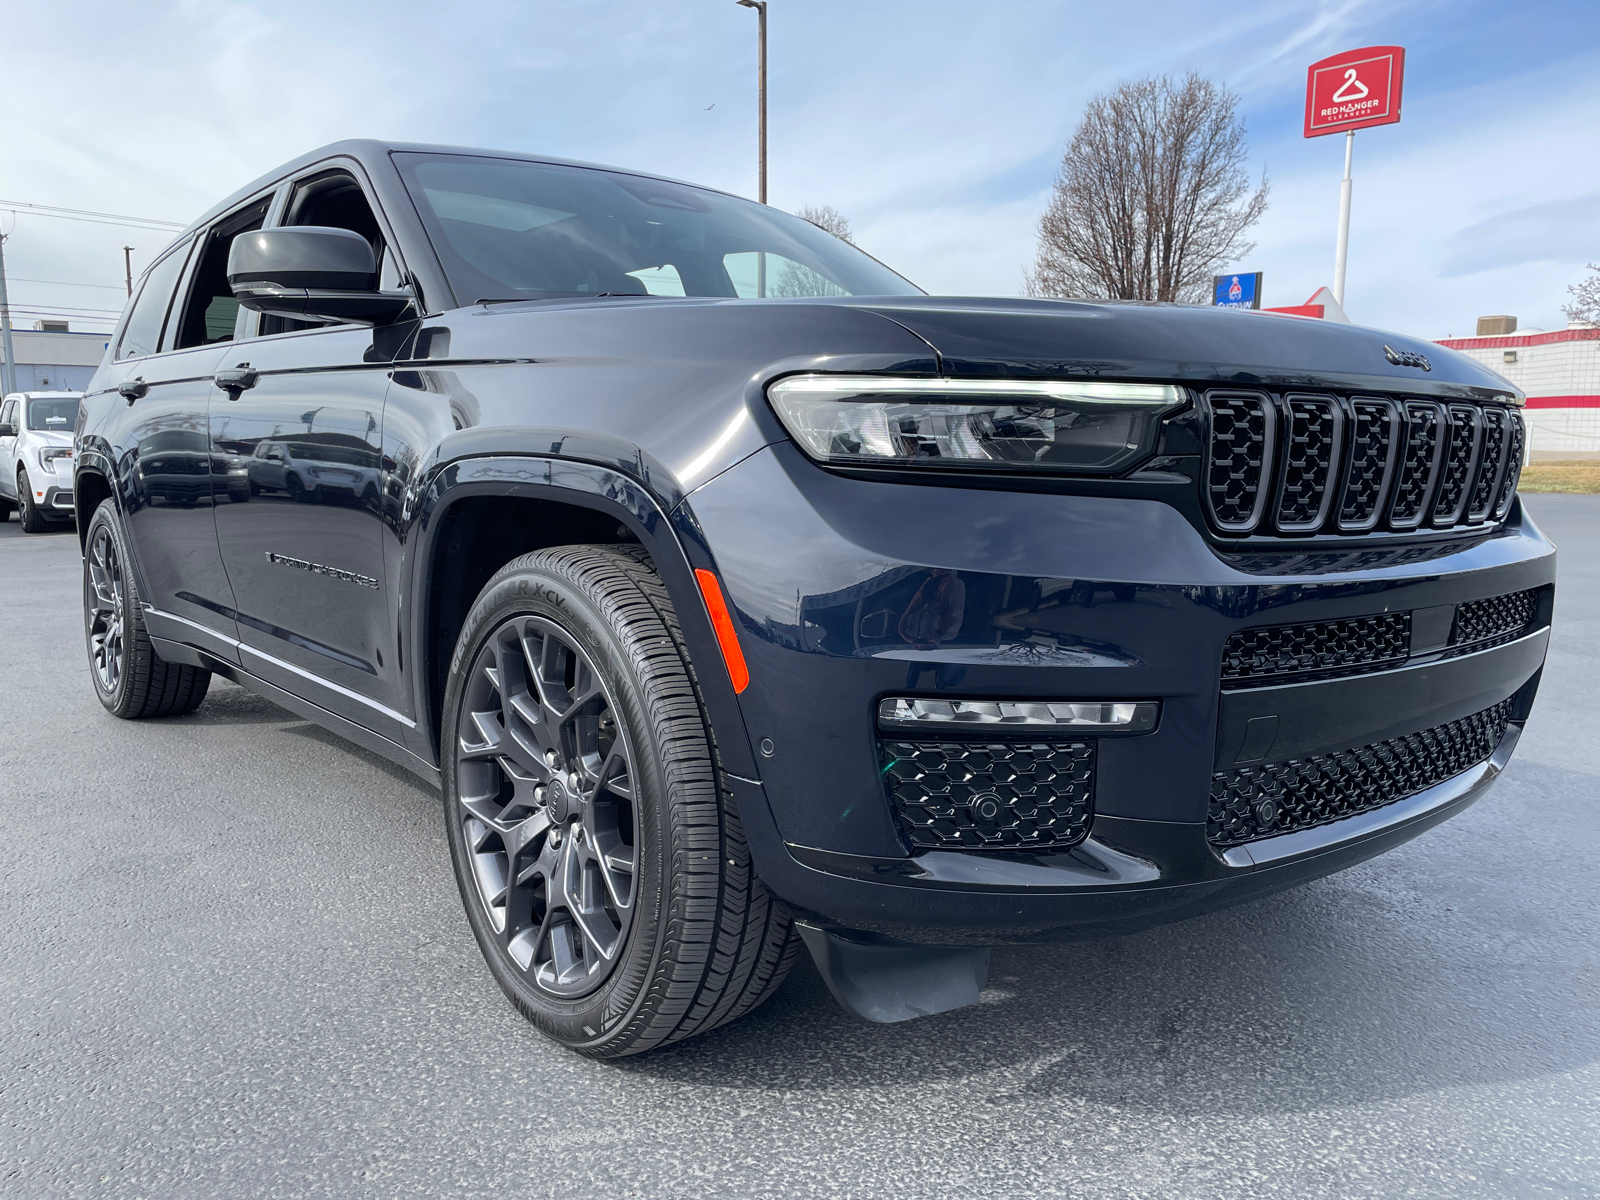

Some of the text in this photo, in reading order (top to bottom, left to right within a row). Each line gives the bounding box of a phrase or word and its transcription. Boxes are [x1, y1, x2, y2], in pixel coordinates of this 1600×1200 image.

[1321, 99, 1379, 117] RED HANGER
[1328, 109, 1371, 121] CLEANERS
[1383, 345, 1431, 372] Jeep
